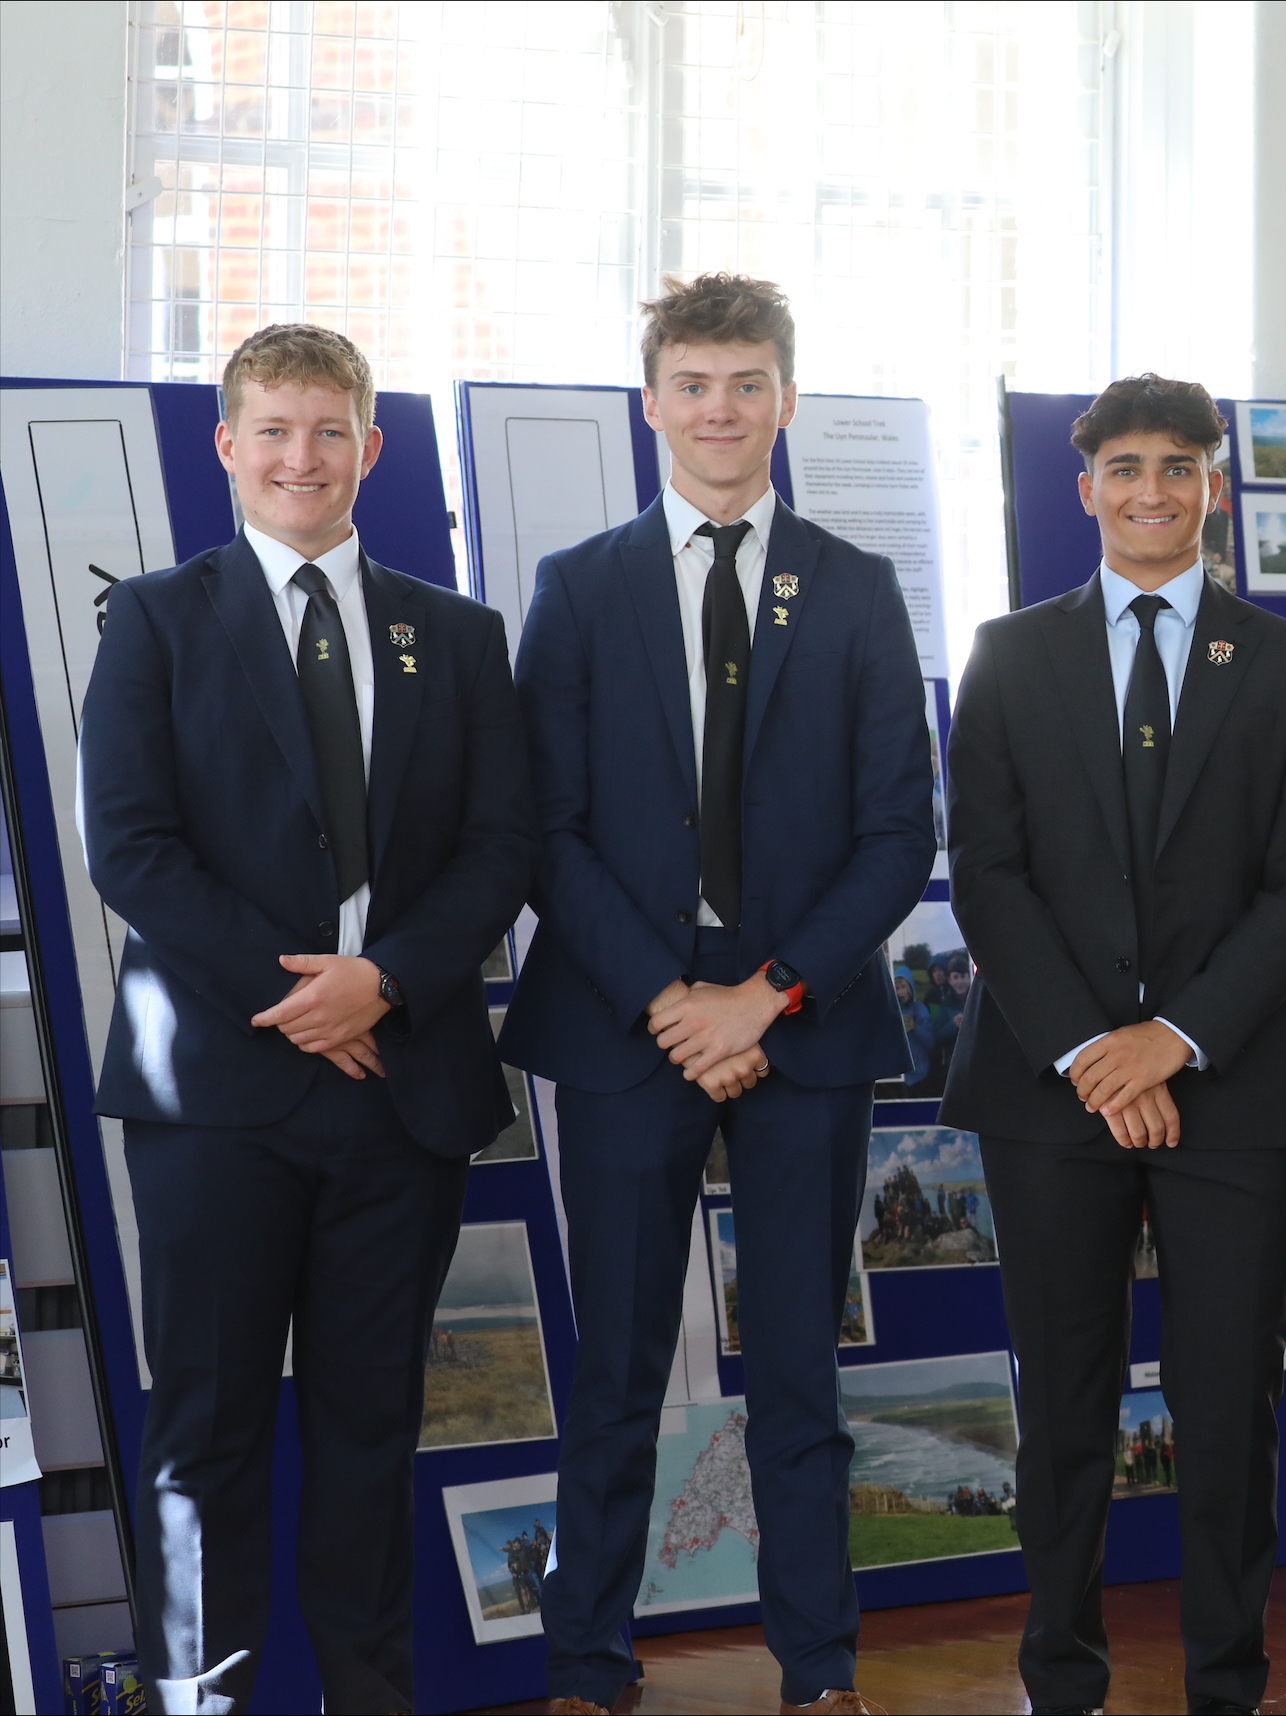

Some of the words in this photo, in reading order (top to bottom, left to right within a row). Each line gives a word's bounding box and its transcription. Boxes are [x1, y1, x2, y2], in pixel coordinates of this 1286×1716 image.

[833, 418, 851, 426] Lower
[852, 418, 872, 427] School
[822, 431, 834, 440] The
[881, 434, 900, 442] Wales
